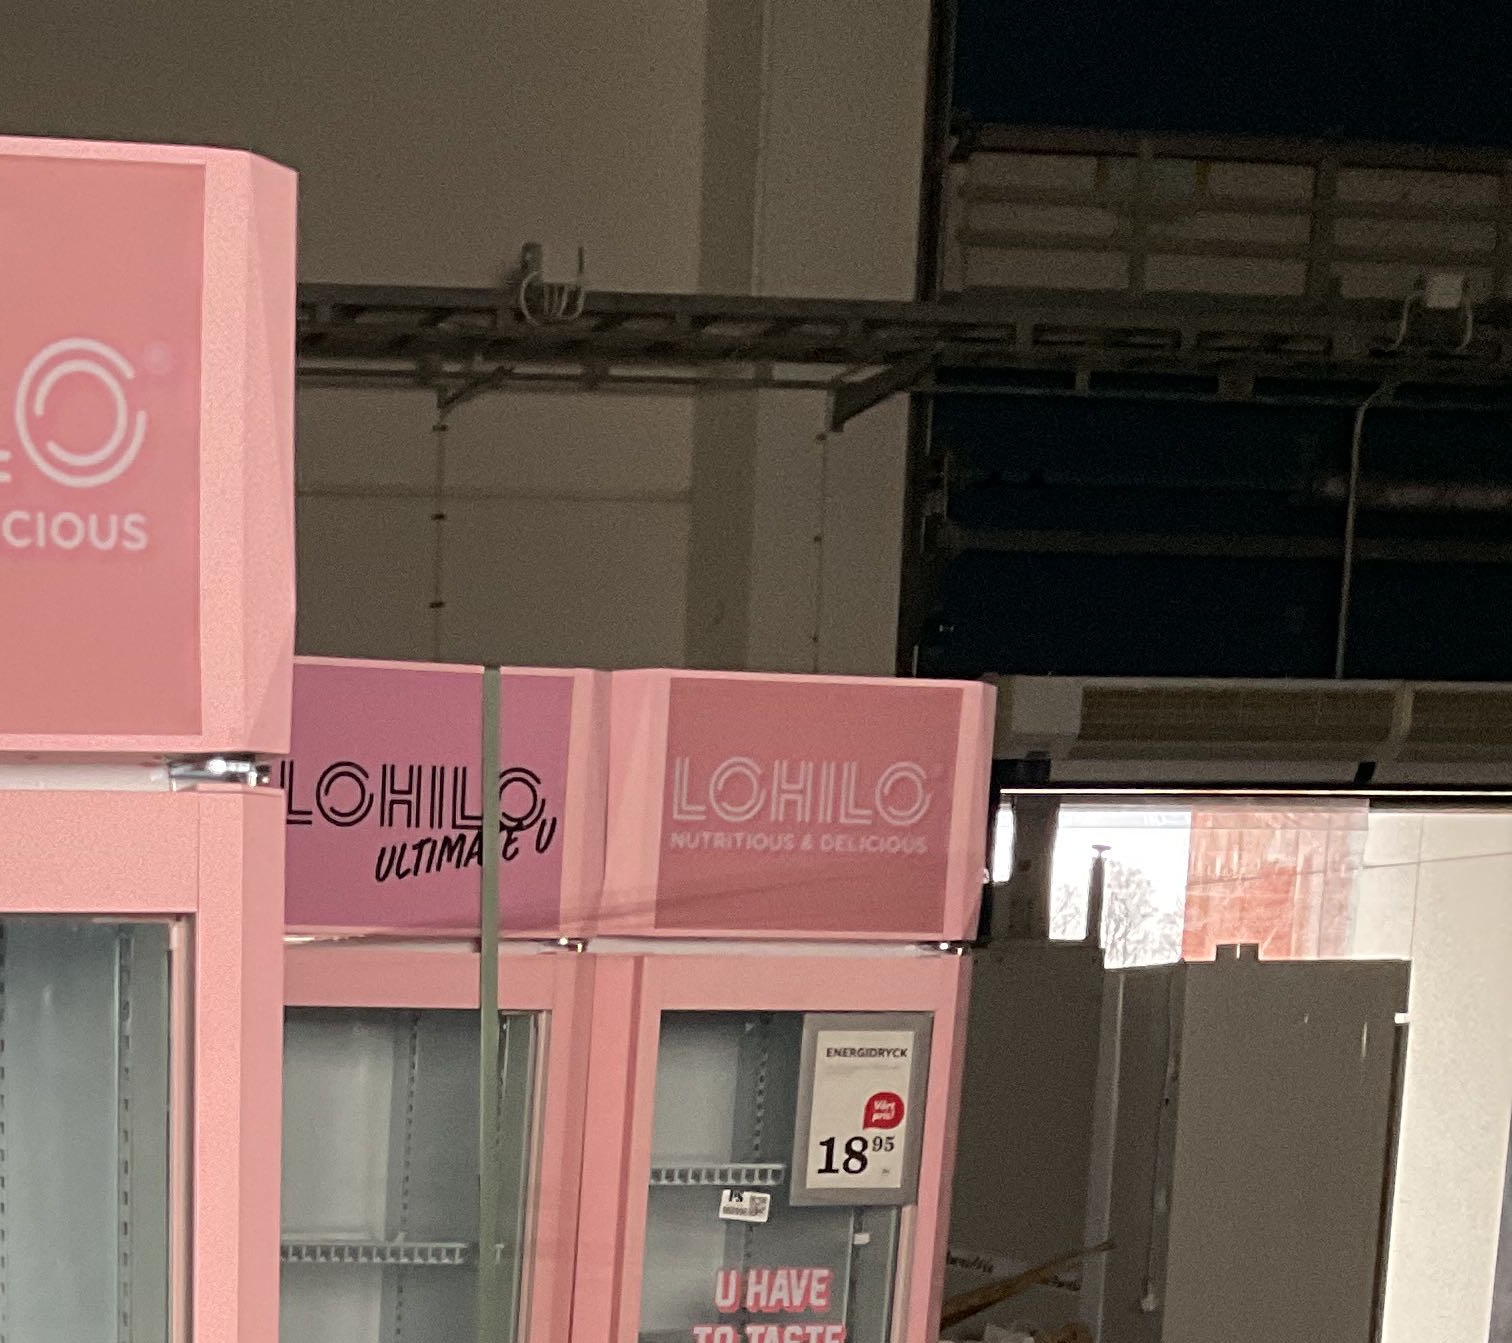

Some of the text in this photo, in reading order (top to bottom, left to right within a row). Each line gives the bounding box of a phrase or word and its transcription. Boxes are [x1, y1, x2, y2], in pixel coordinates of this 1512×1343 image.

[280, 760, 545, 830] LOHILO
[673, 757, 932, 826] LOHILO
[375, 822, 519, 882] ULTIMAE
[671, 831, 928, 853] NUTRITIOUS & DELICIOUS
[826, 1047, 908, 1058] ENERGIDRYCK
[817, 1136, 895, 1174] 18 95
[715, 1268, 832, 1312] U HAVE
